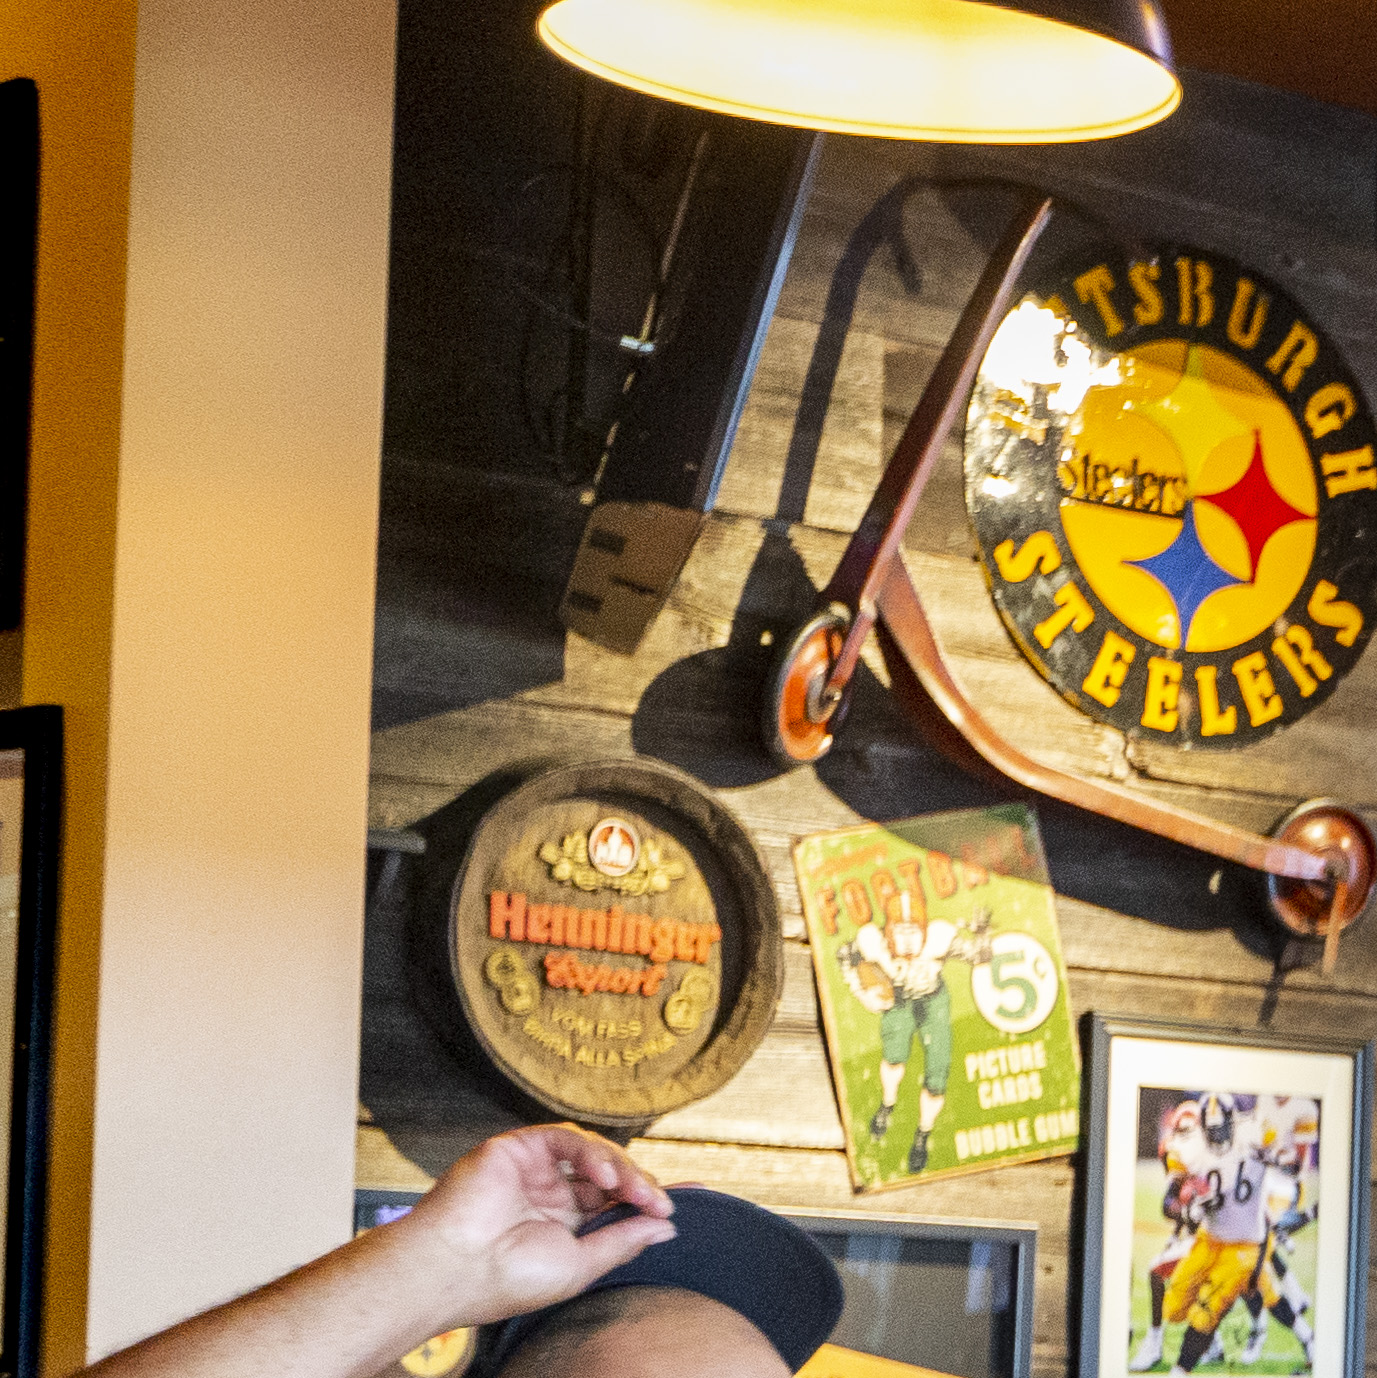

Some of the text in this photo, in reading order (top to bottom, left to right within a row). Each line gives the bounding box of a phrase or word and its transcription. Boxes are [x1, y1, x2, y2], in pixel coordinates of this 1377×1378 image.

[994, 530, 1365, 738] STEELERS
[489, 890, 722, 964] Henninger
[543, 951, 668, 996] Export
[964, 1040, 1048, 1083] PICTURE
[976, 1074, 1044, 1111] CARDS
[1034, 1109, 1078, 1148] GUM
